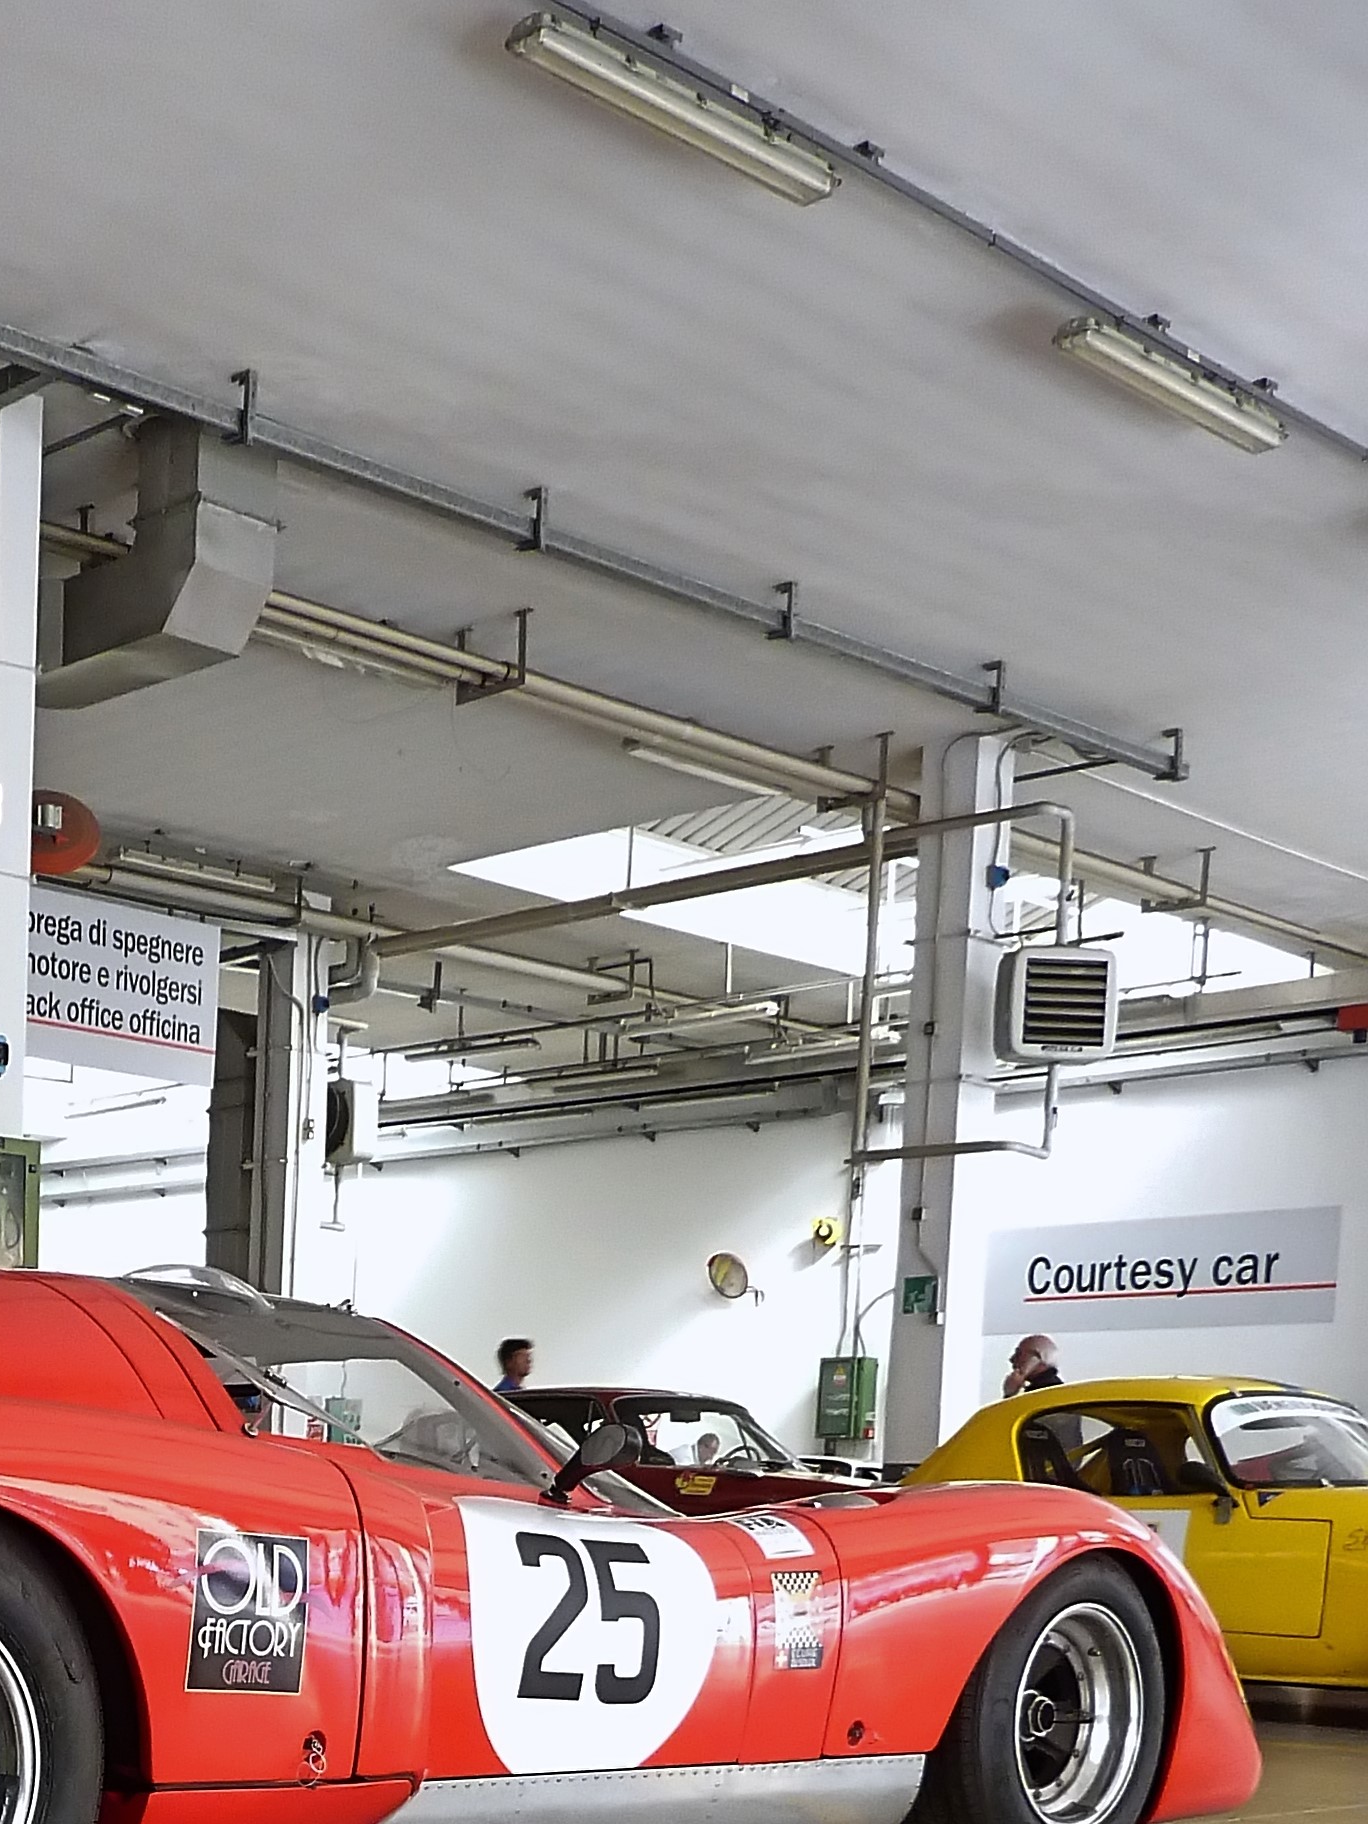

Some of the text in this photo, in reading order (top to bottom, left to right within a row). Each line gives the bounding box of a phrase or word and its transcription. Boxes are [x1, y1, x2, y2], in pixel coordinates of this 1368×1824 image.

[89, 919, 106, 946] di
[113, 929, 203, 966] spegnere
[97, 966, 109, 987] e
[115, 965, 202, 1006] rivolgersi
[67, 997, 123, 1030] office
[129, 1008, 200, 1044] officina
[1028, 1252, 1279, 1298] Courtesy car
[201, 1538, 303, 1616] OLD
[198, 1617, 301, 1658] FACTORY
[515, 1532, 660, 1704] 25
[222, 1659, 272, 1685] GARAGE
